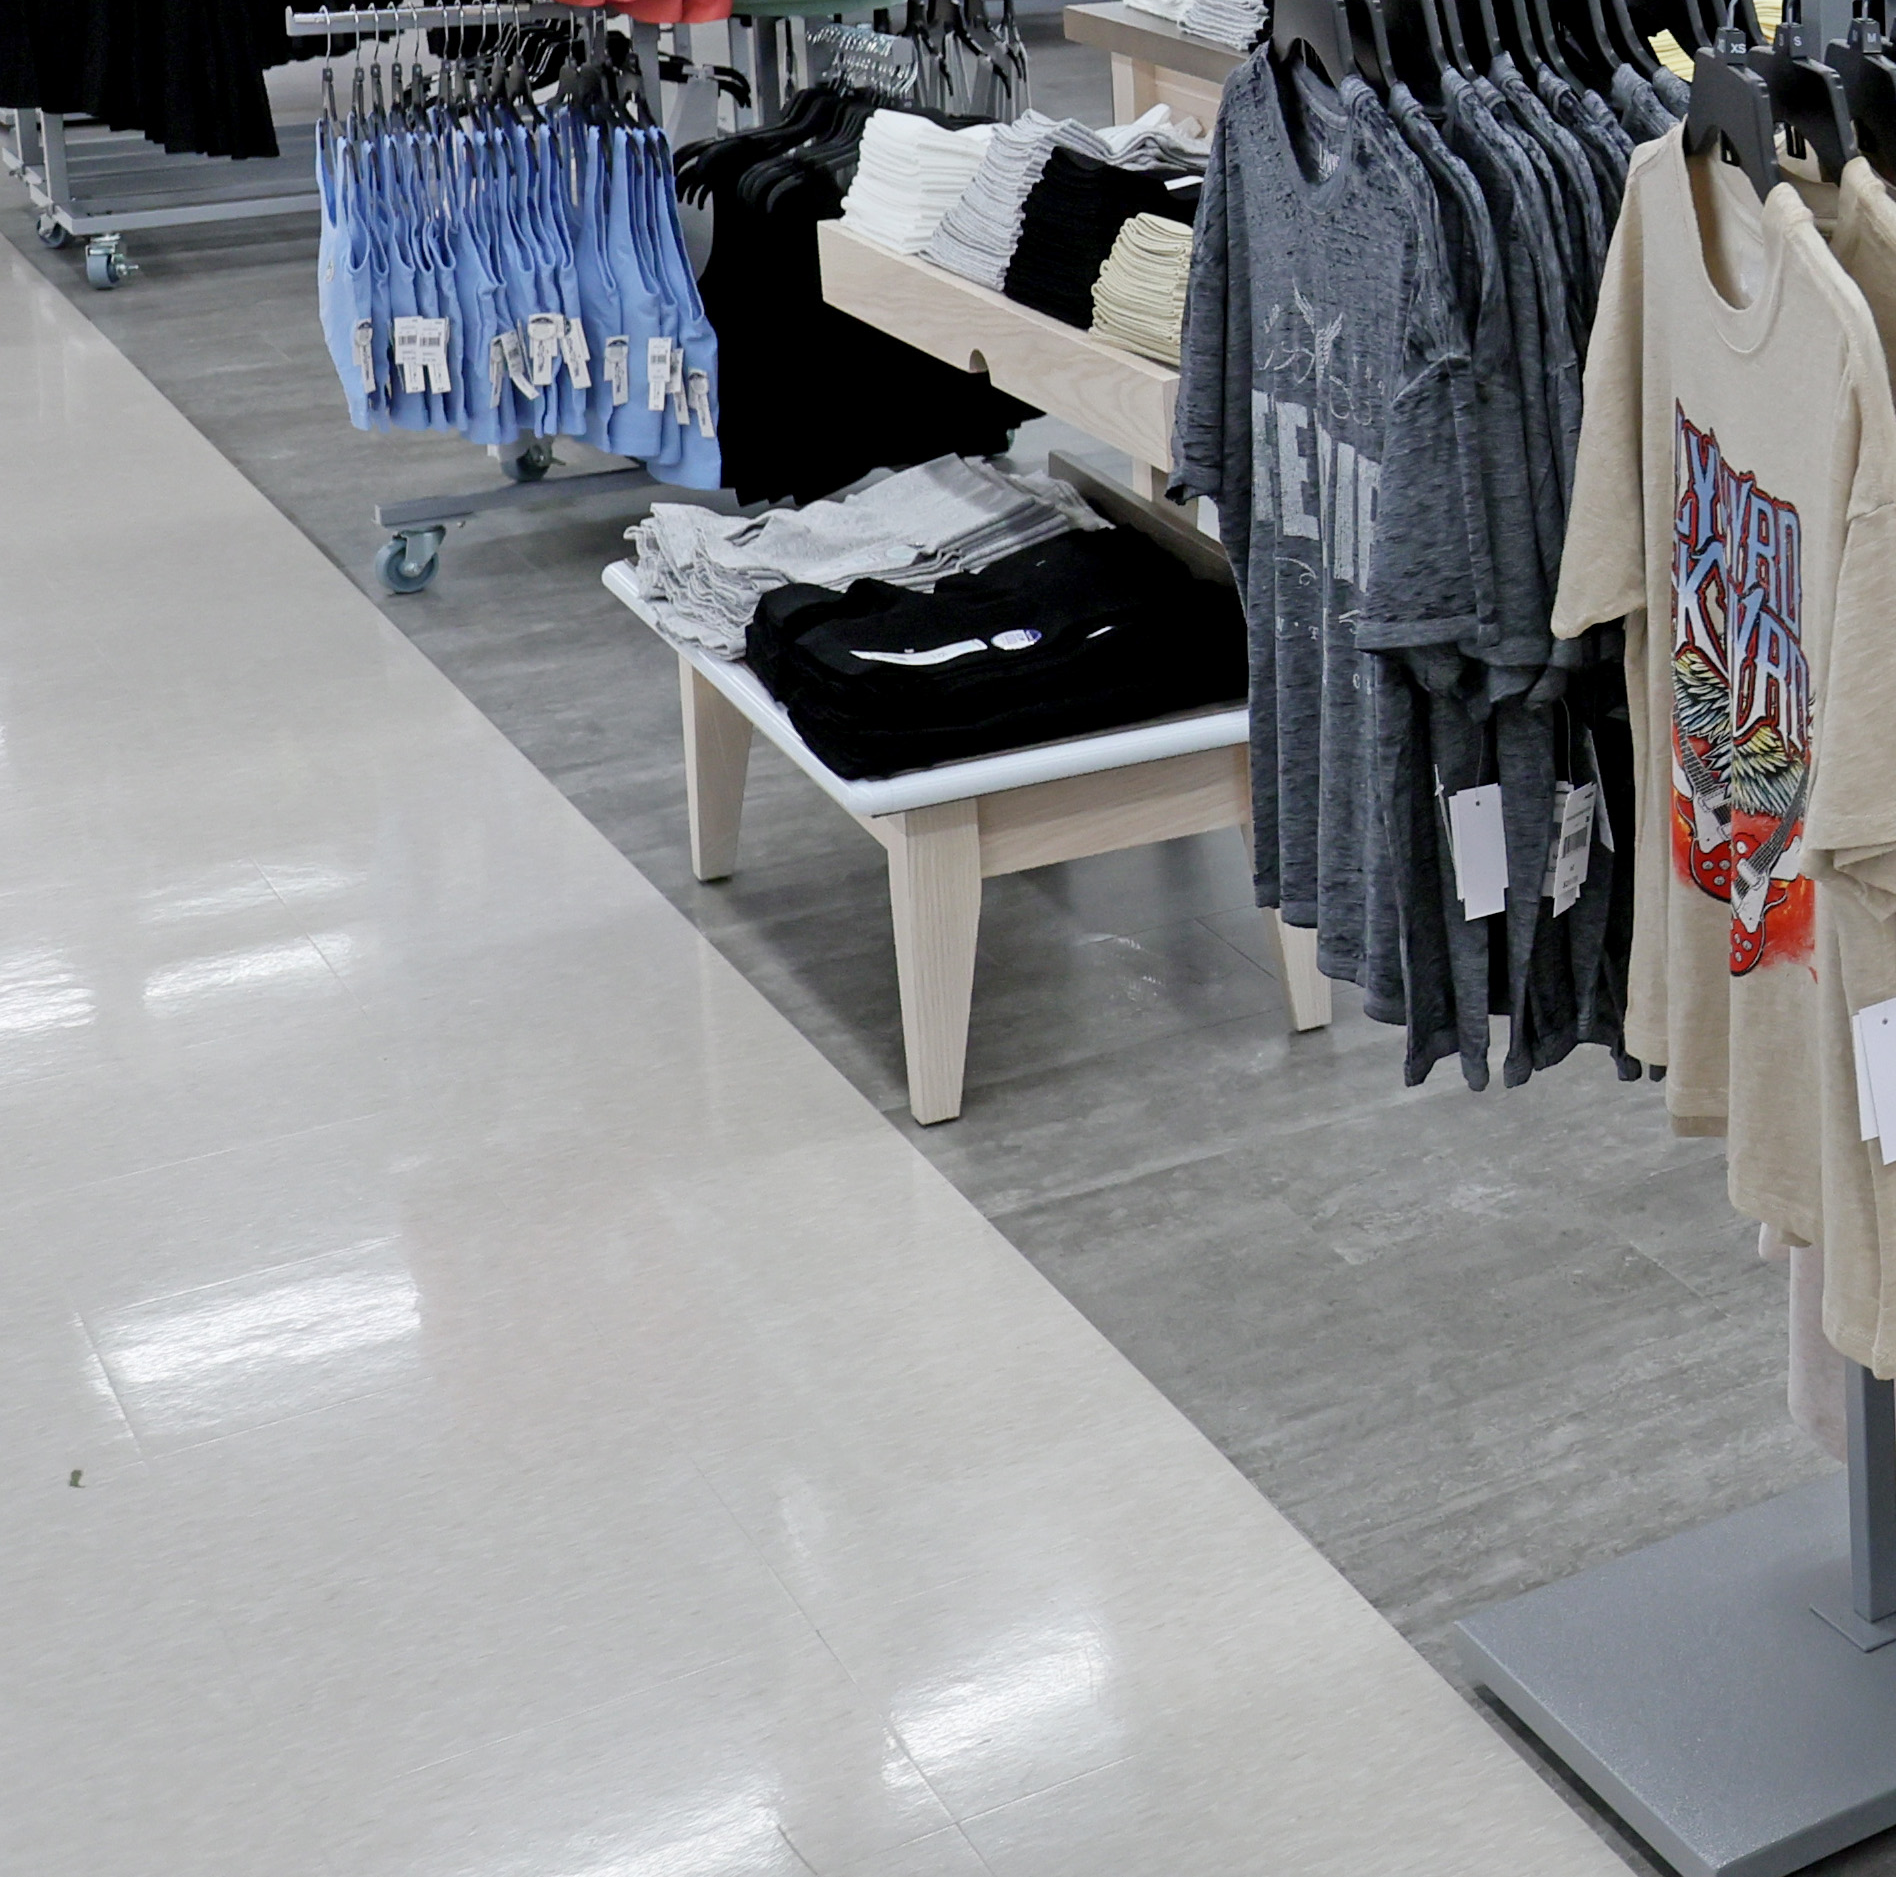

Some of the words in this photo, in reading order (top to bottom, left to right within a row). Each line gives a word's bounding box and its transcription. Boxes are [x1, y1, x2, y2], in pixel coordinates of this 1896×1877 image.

[1794, 36, 1802, 46] S
[1867, 33, 1876, 43] M
[1730, 43, 1746, 54] XS
